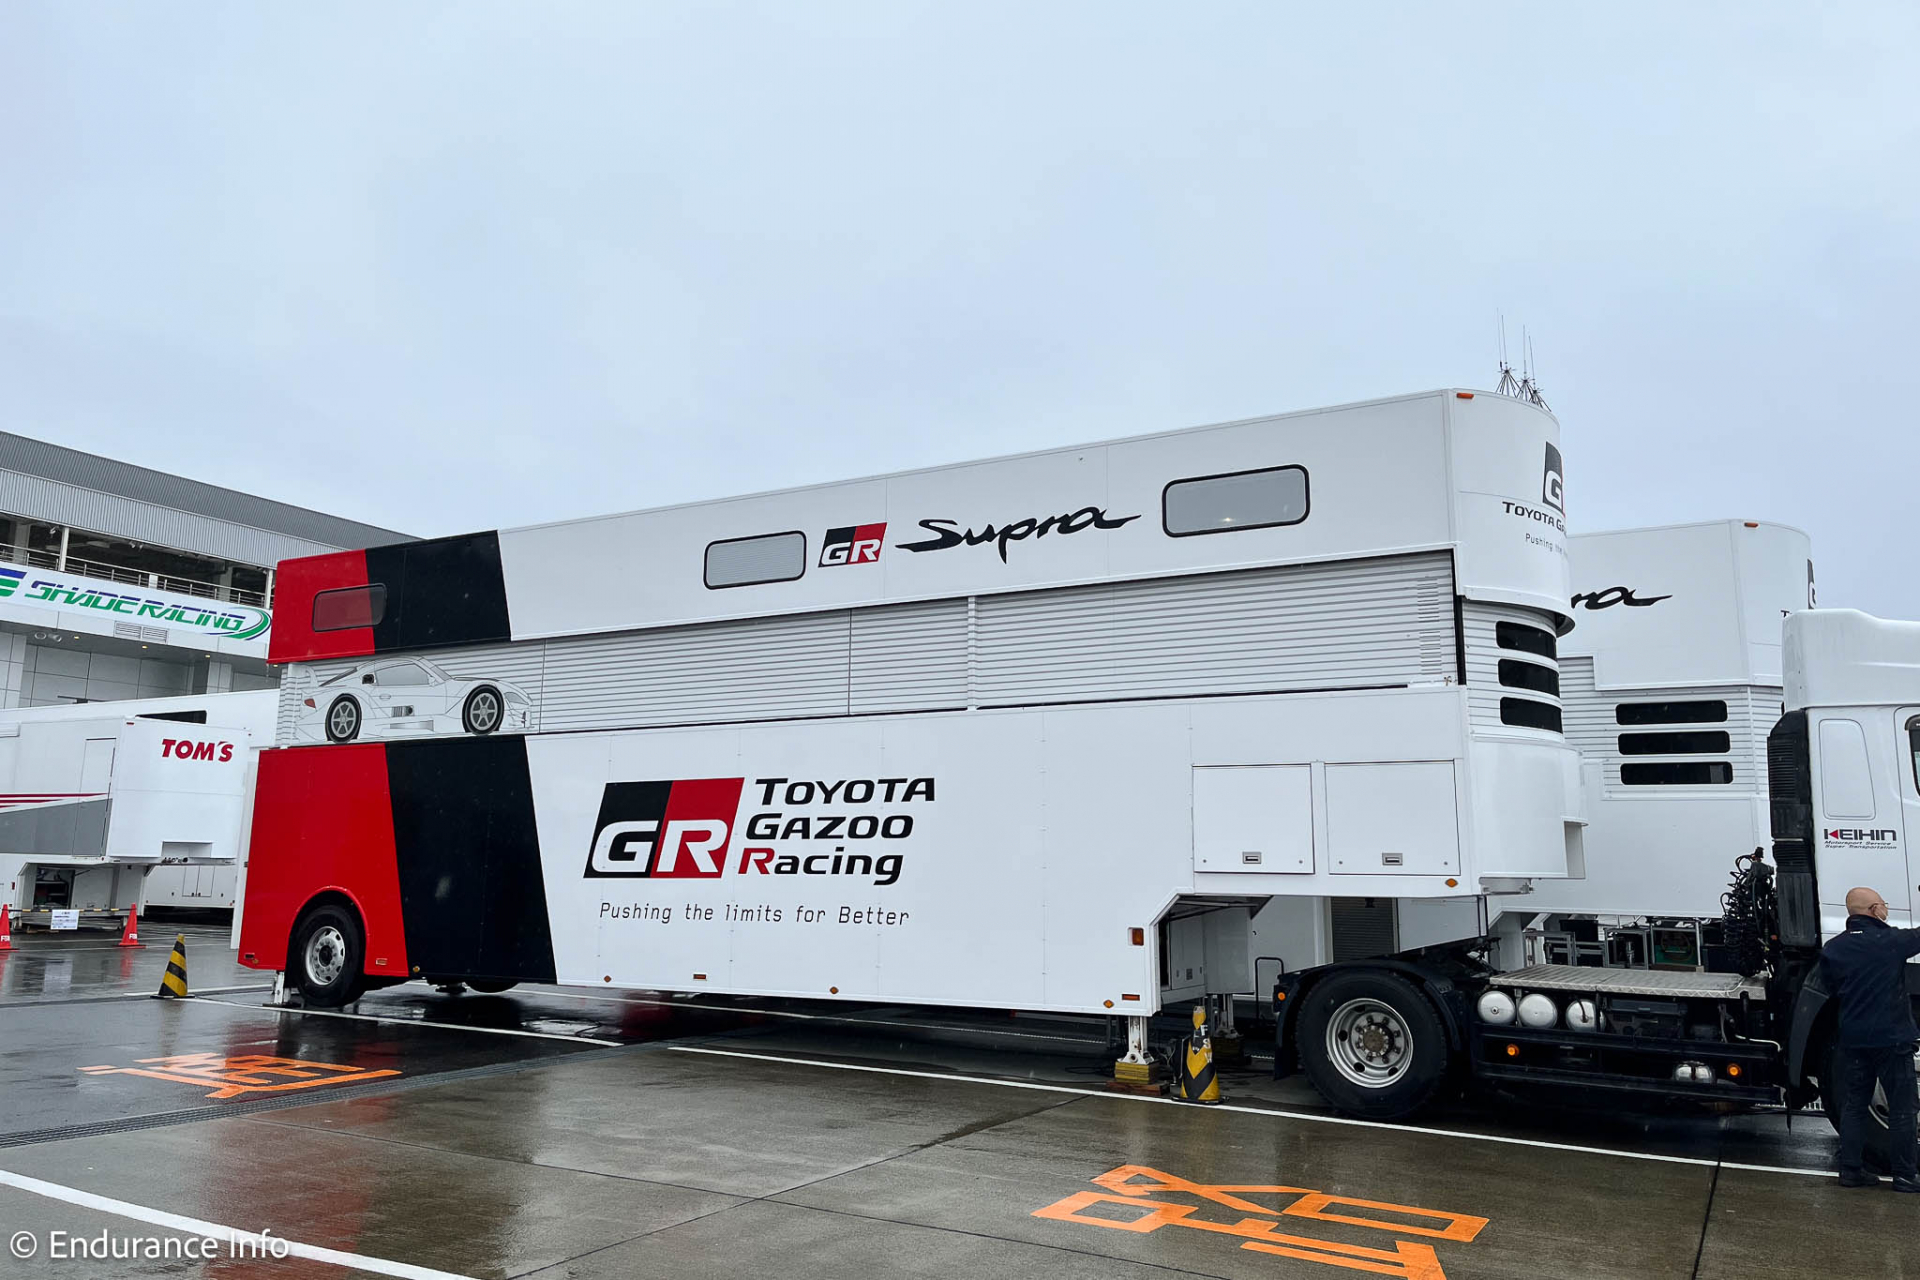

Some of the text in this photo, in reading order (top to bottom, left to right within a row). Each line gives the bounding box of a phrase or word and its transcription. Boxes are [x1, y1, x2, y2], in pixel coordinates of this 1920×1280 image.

[1502, 501, 1555, 527] TOYOTA
[895, 507, 1142, 564] Supra
[1525, 533, 1553, 552] Pushing
[24, 580, 246, 631] SHADE RACING
[162, 738, 234, 762] TOM'S
[755, 777, 935, 805] TOYOTA
[745, 813, 914, 840] GAZOO
[1823, 828, 1897, 841] KEIHIN
[738, 846, 904, 886] Racing
[599, 902, 910, 926] Pushing the limits for Better
